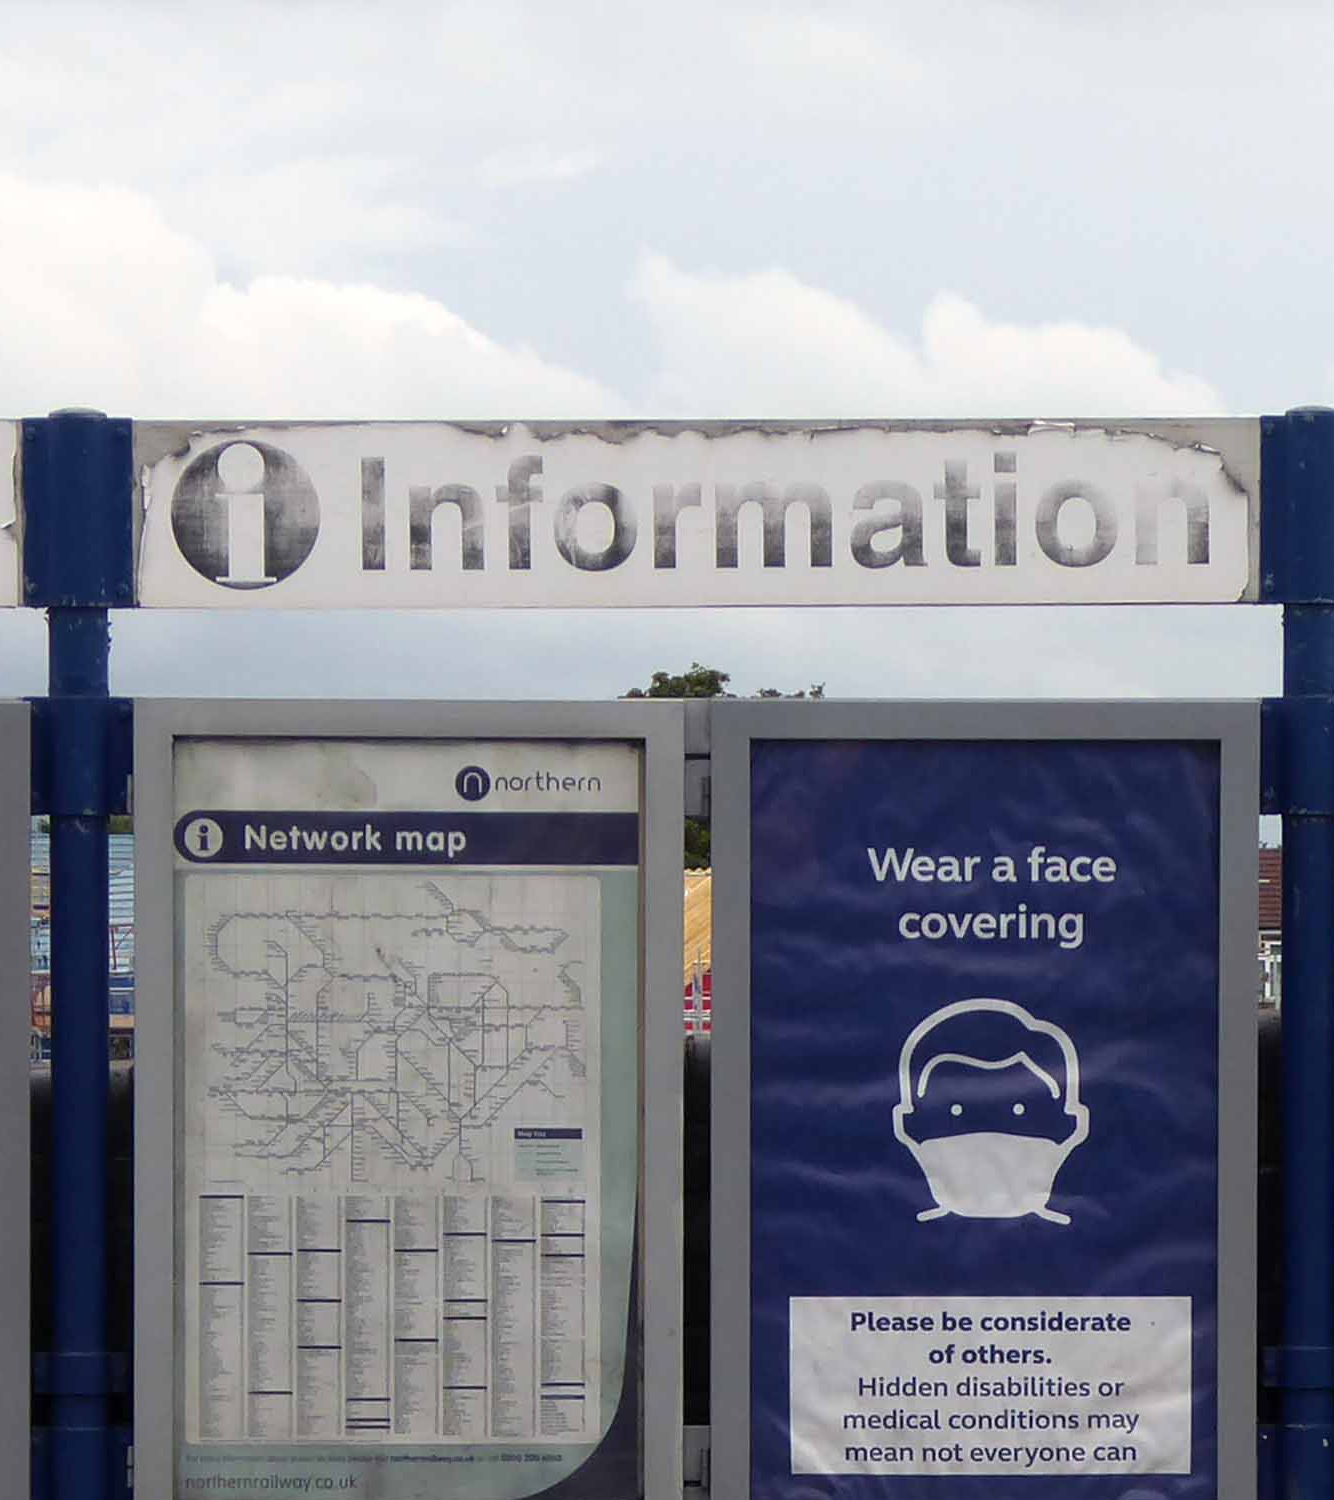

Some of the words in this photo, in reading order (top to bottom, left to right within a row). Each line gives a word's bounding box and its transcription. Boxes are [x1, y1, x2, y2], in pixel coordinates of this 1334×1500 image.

[359, 452, 1215, 572] Information
[494, 770, 602, 792] northern
[244, 823, 382, 852] Network
[395, 830, 467, 859] map
[867, 847, 982, 883] Wear
[991, 855, 1018, 883] a
[1026, 846, 1117, 883] face
[898, 903, 1084, 950] covering
[850, 1311, 935, 1332] Please
[941, 1310, 973, 1332] be
[980, 1310, 1132, 1332] considerate
[928, 1343, 956, 1365] of
[961, 1343, 1052, 1365] others.
[858, 1376, 948, 1397] Hidden
[955, 1376, 1091, 1398] disabilities
[1097, 1381, 1125, 1398] or
[843, 1408, 942, 1430] medical
[948, 1408, 1080, 1430] conditions
[1087, 1413, 1140, 1434] may
[844, 1446, 914, 1462] mean
[921, 1443, 964, 1463] not
[969, 1446, 1086, 1468] everyone
[1093, 1446, 1137, 1462] can
[183, 1473, 359, 1496] northernrailway.co.uk
